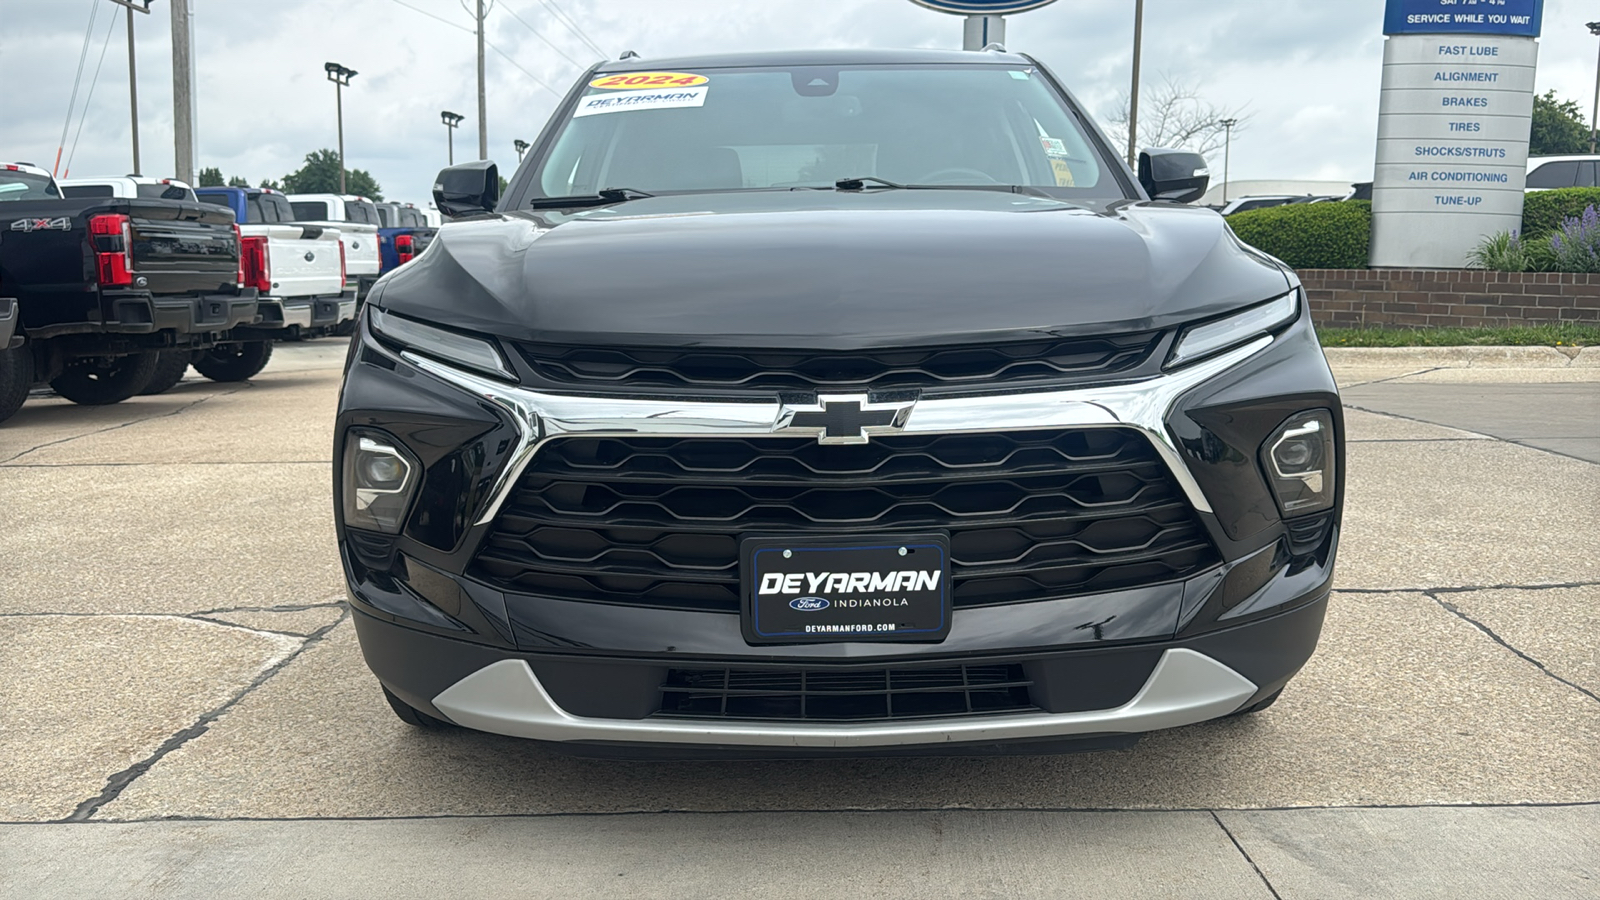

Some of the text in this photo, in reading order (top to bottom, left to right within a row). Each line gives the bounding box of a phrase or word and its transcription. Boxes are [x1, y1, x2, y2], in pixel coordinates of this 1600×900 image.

[1407, 14, 1530, 25] SERVICE WHILE YOU WAIT
[1438, 46, 1499, 56] FAST LUBE
[598, 76, 698, 87] 2024
[1434, 72, 1499, 82] ALIGNMENT
[586, 92, 699, 107] DEYARMAN
[1442, 97, 1488, 107] BRAKES
[1449, 122, 1480, 132] TIRES
[1415, 146, 1506, 158] SHOCKS/STRUTS
[1408, 171, 1508, 183] AIR CONDITIONING
[1435, 195, 1482, 206] TUNE-UP
[758, 570, 941, 595] DEYARMAN
[797, 597, 909, 609] Ford INDIANOLA
[805, 623, 896, 633] DEYARMANFORD.COM
